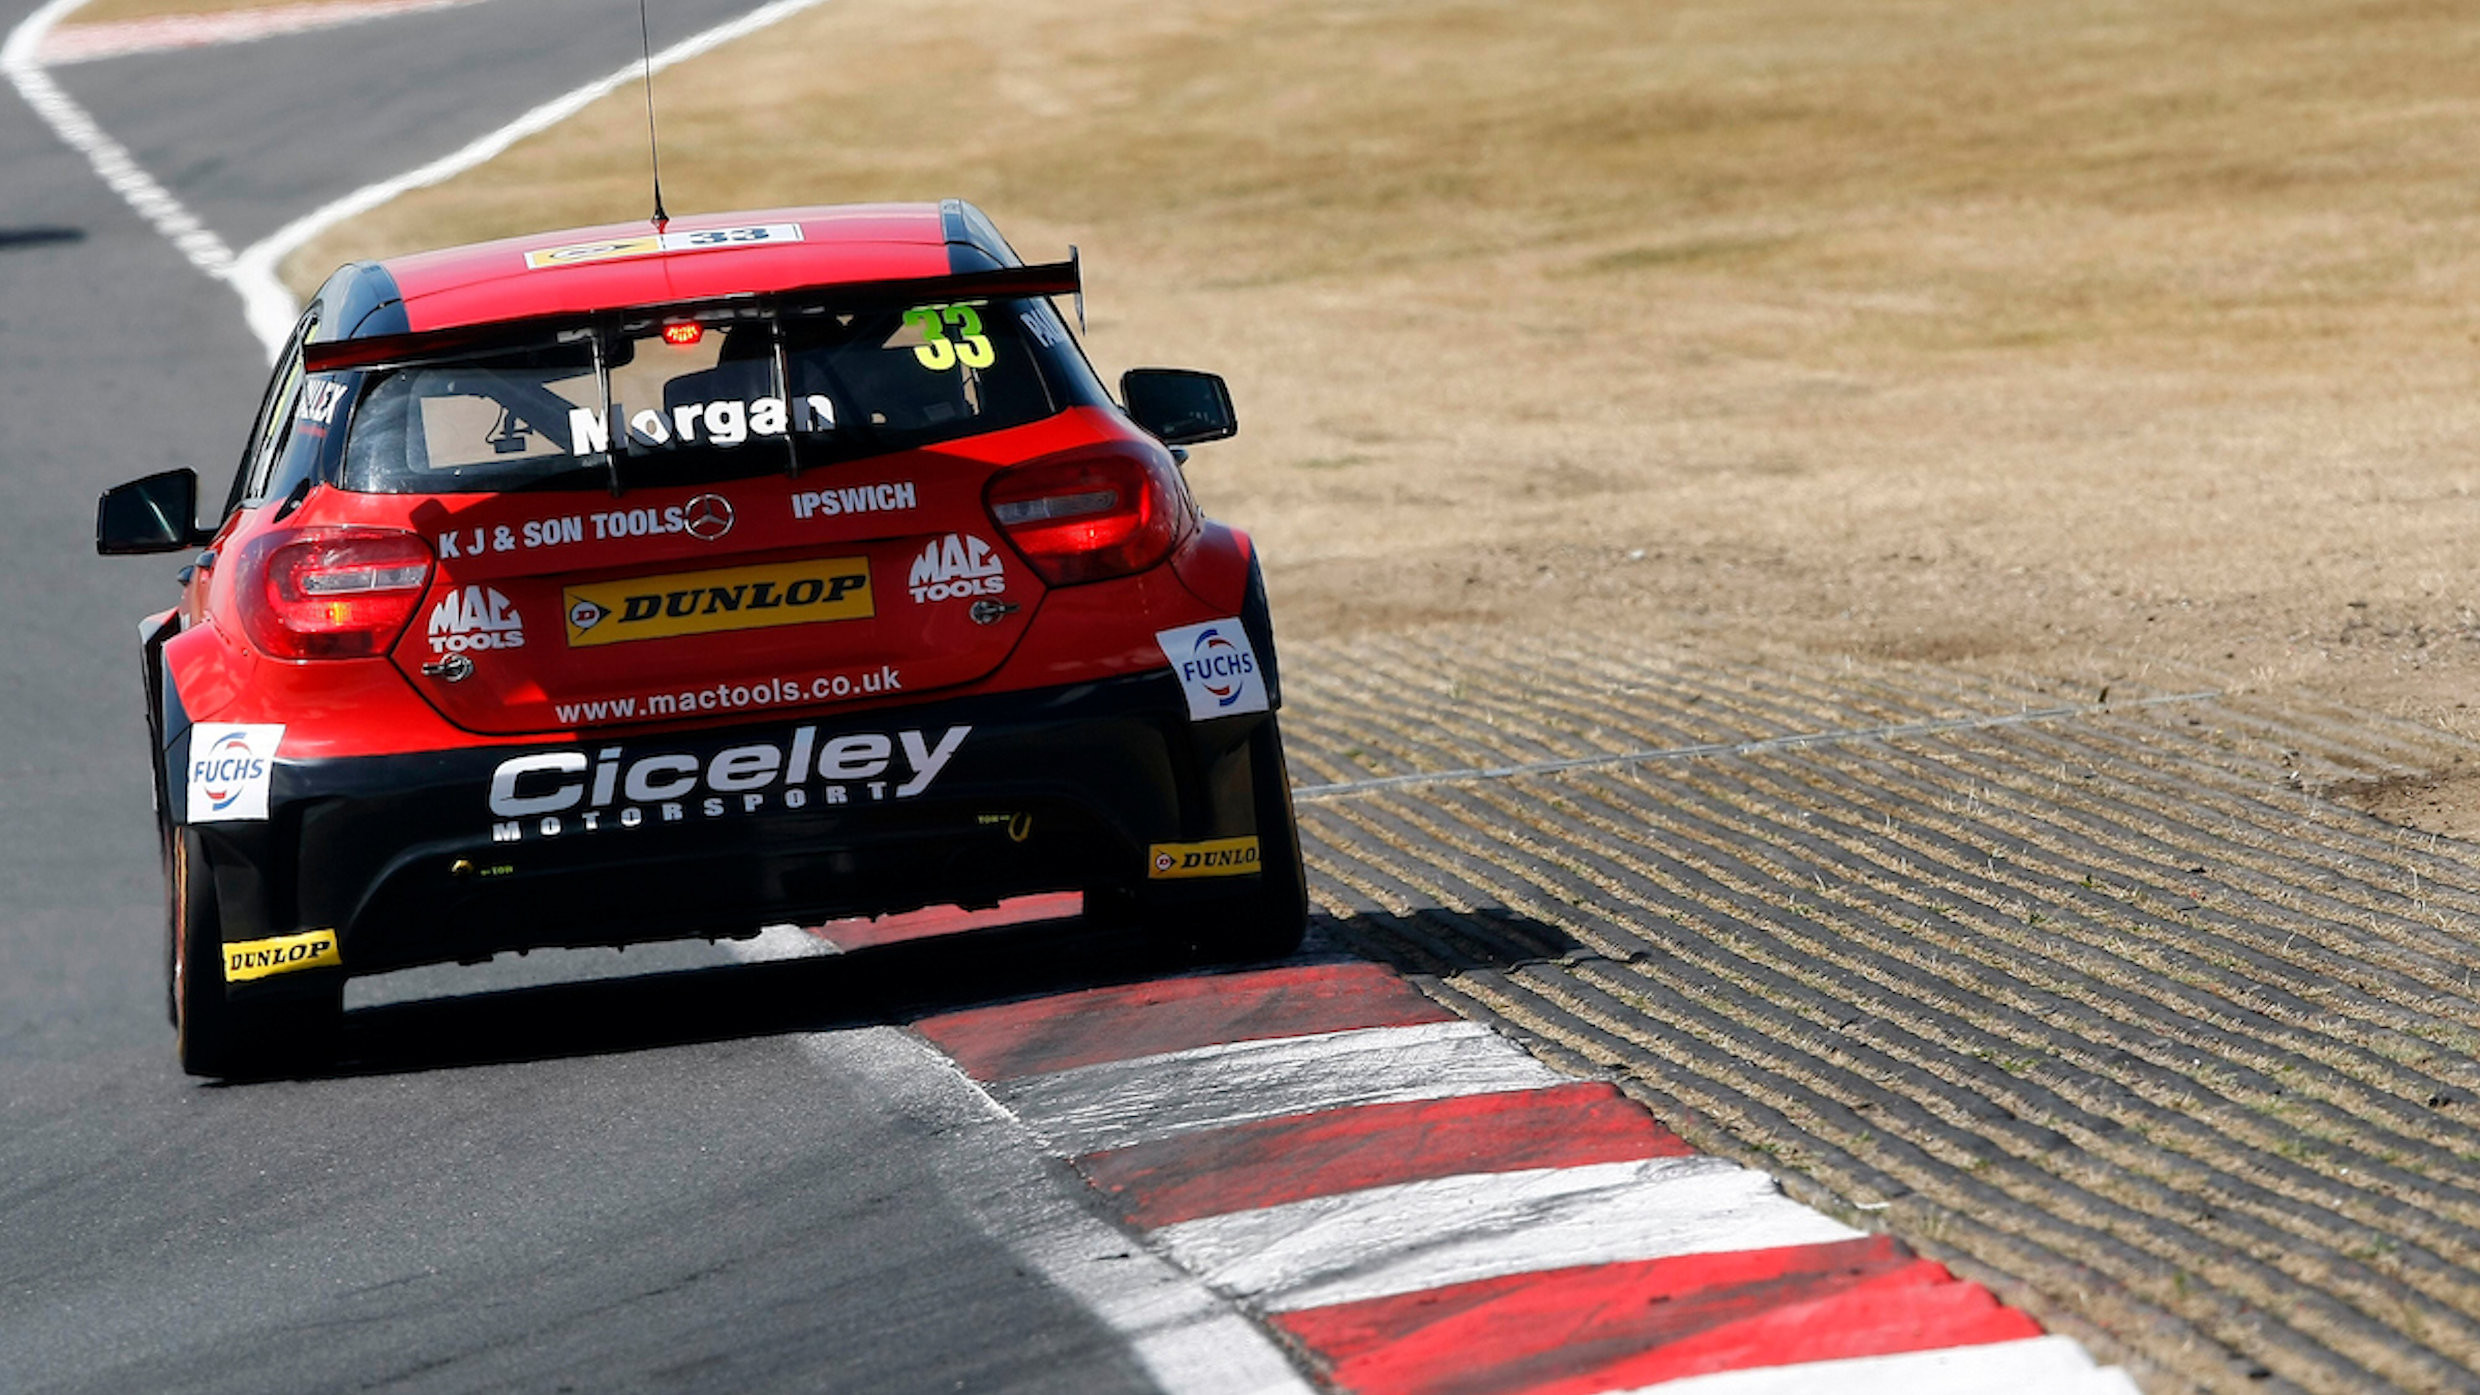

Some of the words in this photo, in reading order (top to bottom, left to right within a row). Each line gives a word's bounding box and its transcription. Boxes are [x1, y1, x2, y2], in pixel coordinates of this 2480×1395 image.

[689, 227, 770, 245] 33
[902, 301, 996, 371] 33
[568, 394, 837, 457] Morgan
[791, 481, 917, 519] IPSWICH
[438, 529, 461, 560] K
[466, 528, 485, 556] J
[492, 525, 516, 552] &
[522, 515, 583, 548] SON
[590, 505, 684, 540] TOOLS
[909, 533, 1004, 588] MAC
[428, 584, 524, 637] MAC
[617, 574, 867, 624] DUNLOP
[909, 576, 1006, 604] TOOLS
[429, 631, 526, 654] TOOLS
[1182, 652, 1253, 682] FUCHS
[555, 665, 902, 724] www.mactools.co.uk
[193, 758, 265, 784] FUCHS
[488, 725, 973, 818] Ciceley
[492, 781, 888, 843] MOTORSPORT
[1180, 846, 1260, 869] DUNLO
[230, 940, 332, 972] DUNLOP
